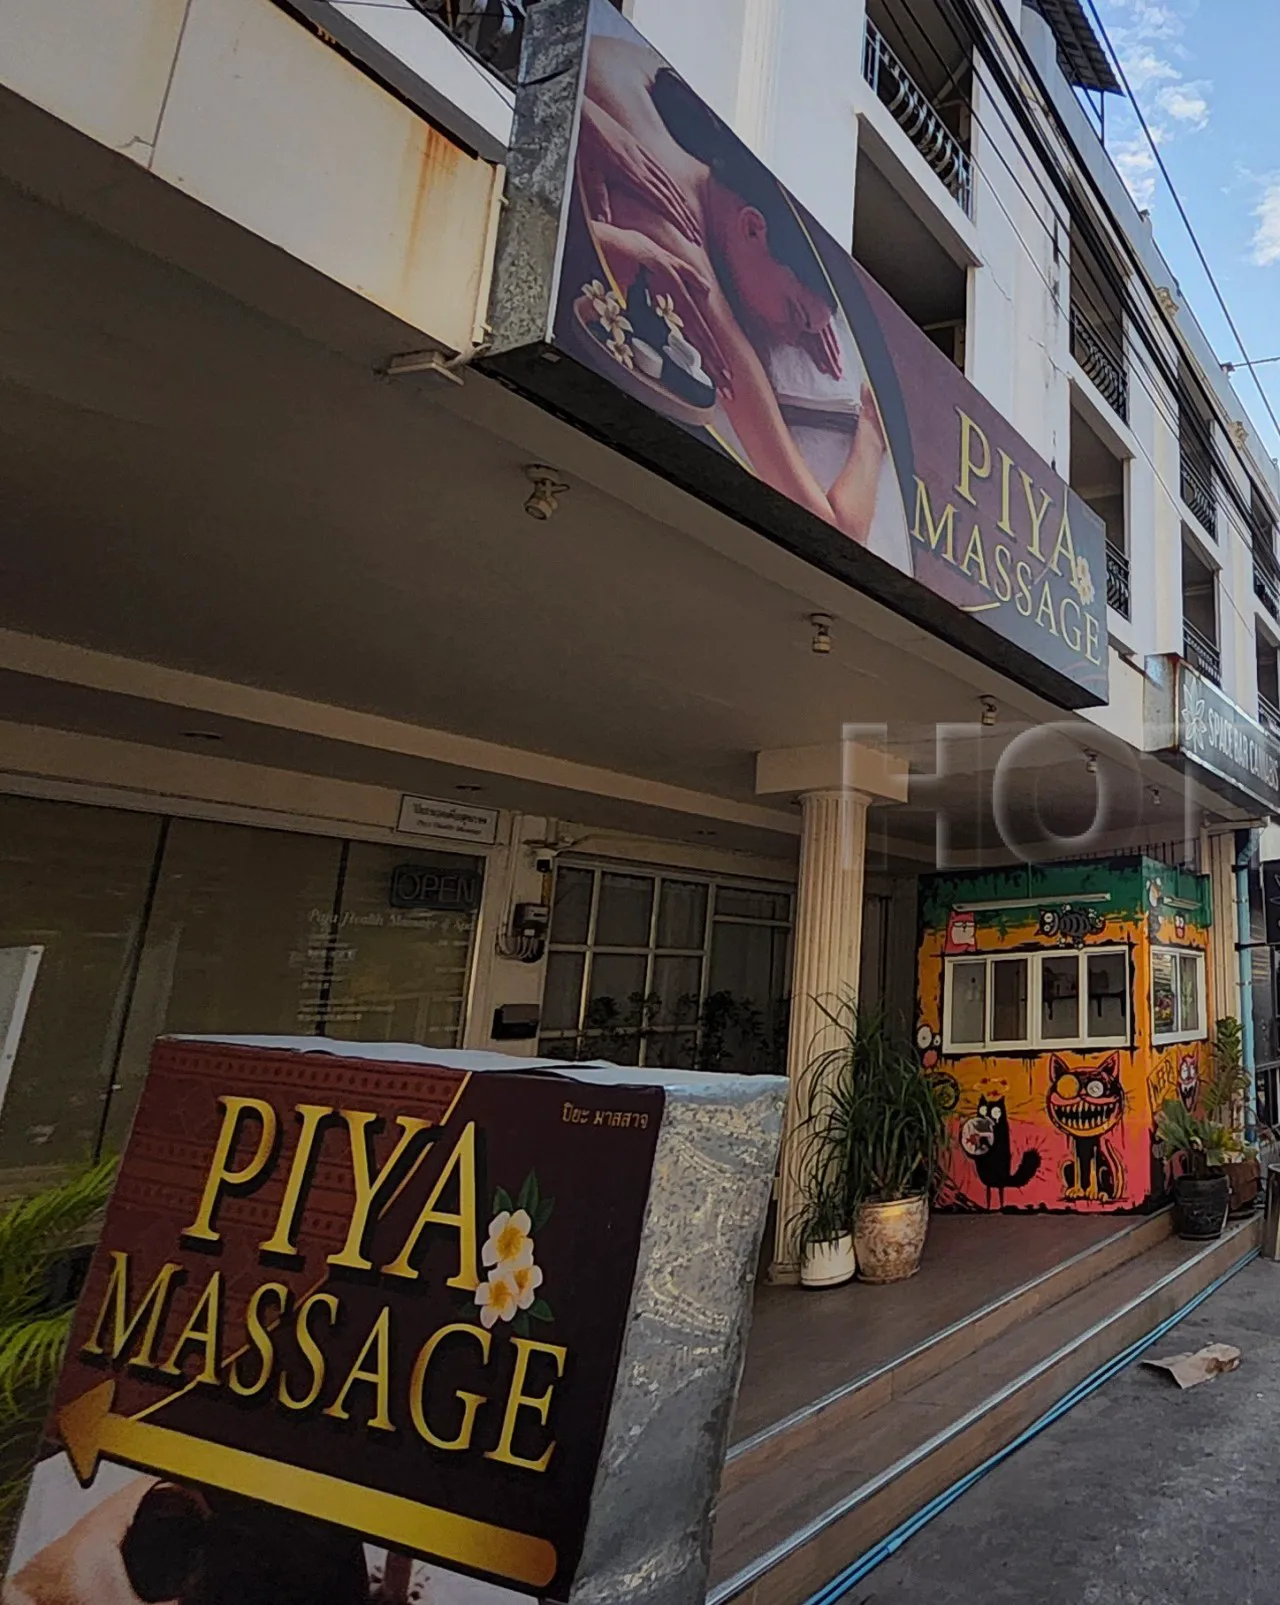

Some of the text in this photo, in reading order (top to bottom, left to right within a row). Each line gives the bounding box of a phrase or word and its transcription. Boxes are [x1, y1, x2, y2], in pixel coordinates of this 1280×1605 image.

[910, 475, 1102, 666] MASSAGE
[955, 406, 1080, 590] PIYA
[400, 873, 476, 902] OPEN
[181, 1094, 482, 1293] PIYA
[81, 1251, 568, 1472] MASSAGE
